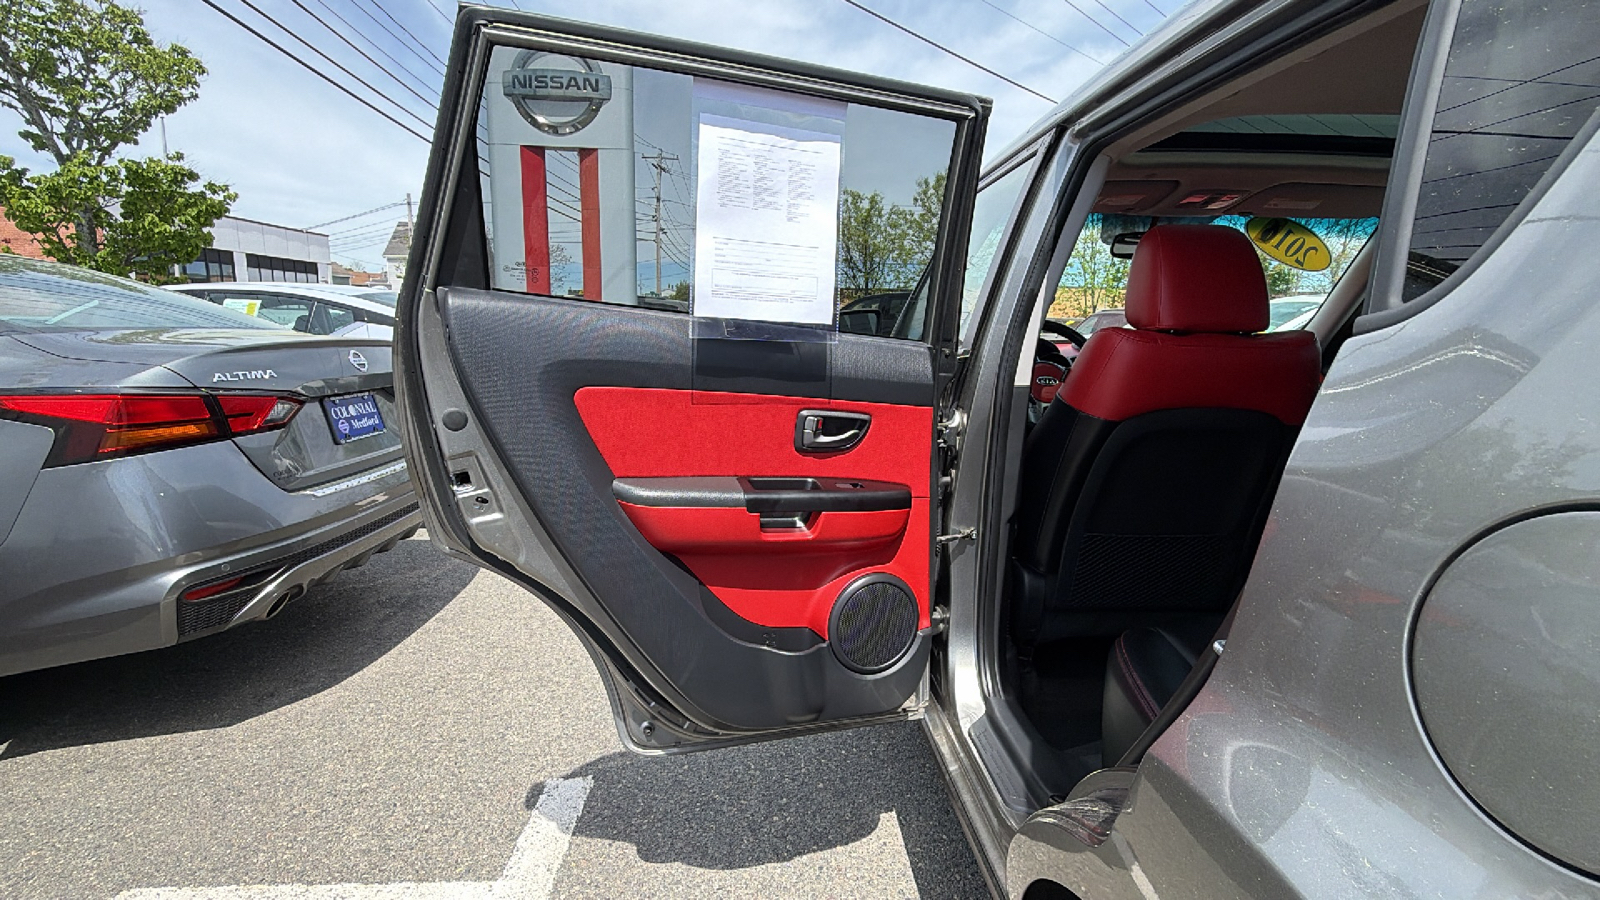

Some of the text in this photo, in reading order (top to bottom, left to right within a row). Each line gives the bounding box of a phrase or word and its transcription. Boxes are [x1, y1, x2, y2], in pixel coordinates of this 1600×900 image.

[511, 74, 600, 93] NISSAN
[212, 369, 278, 382] ALTIMA
[331, 401, 377, 419] COLONIAL
